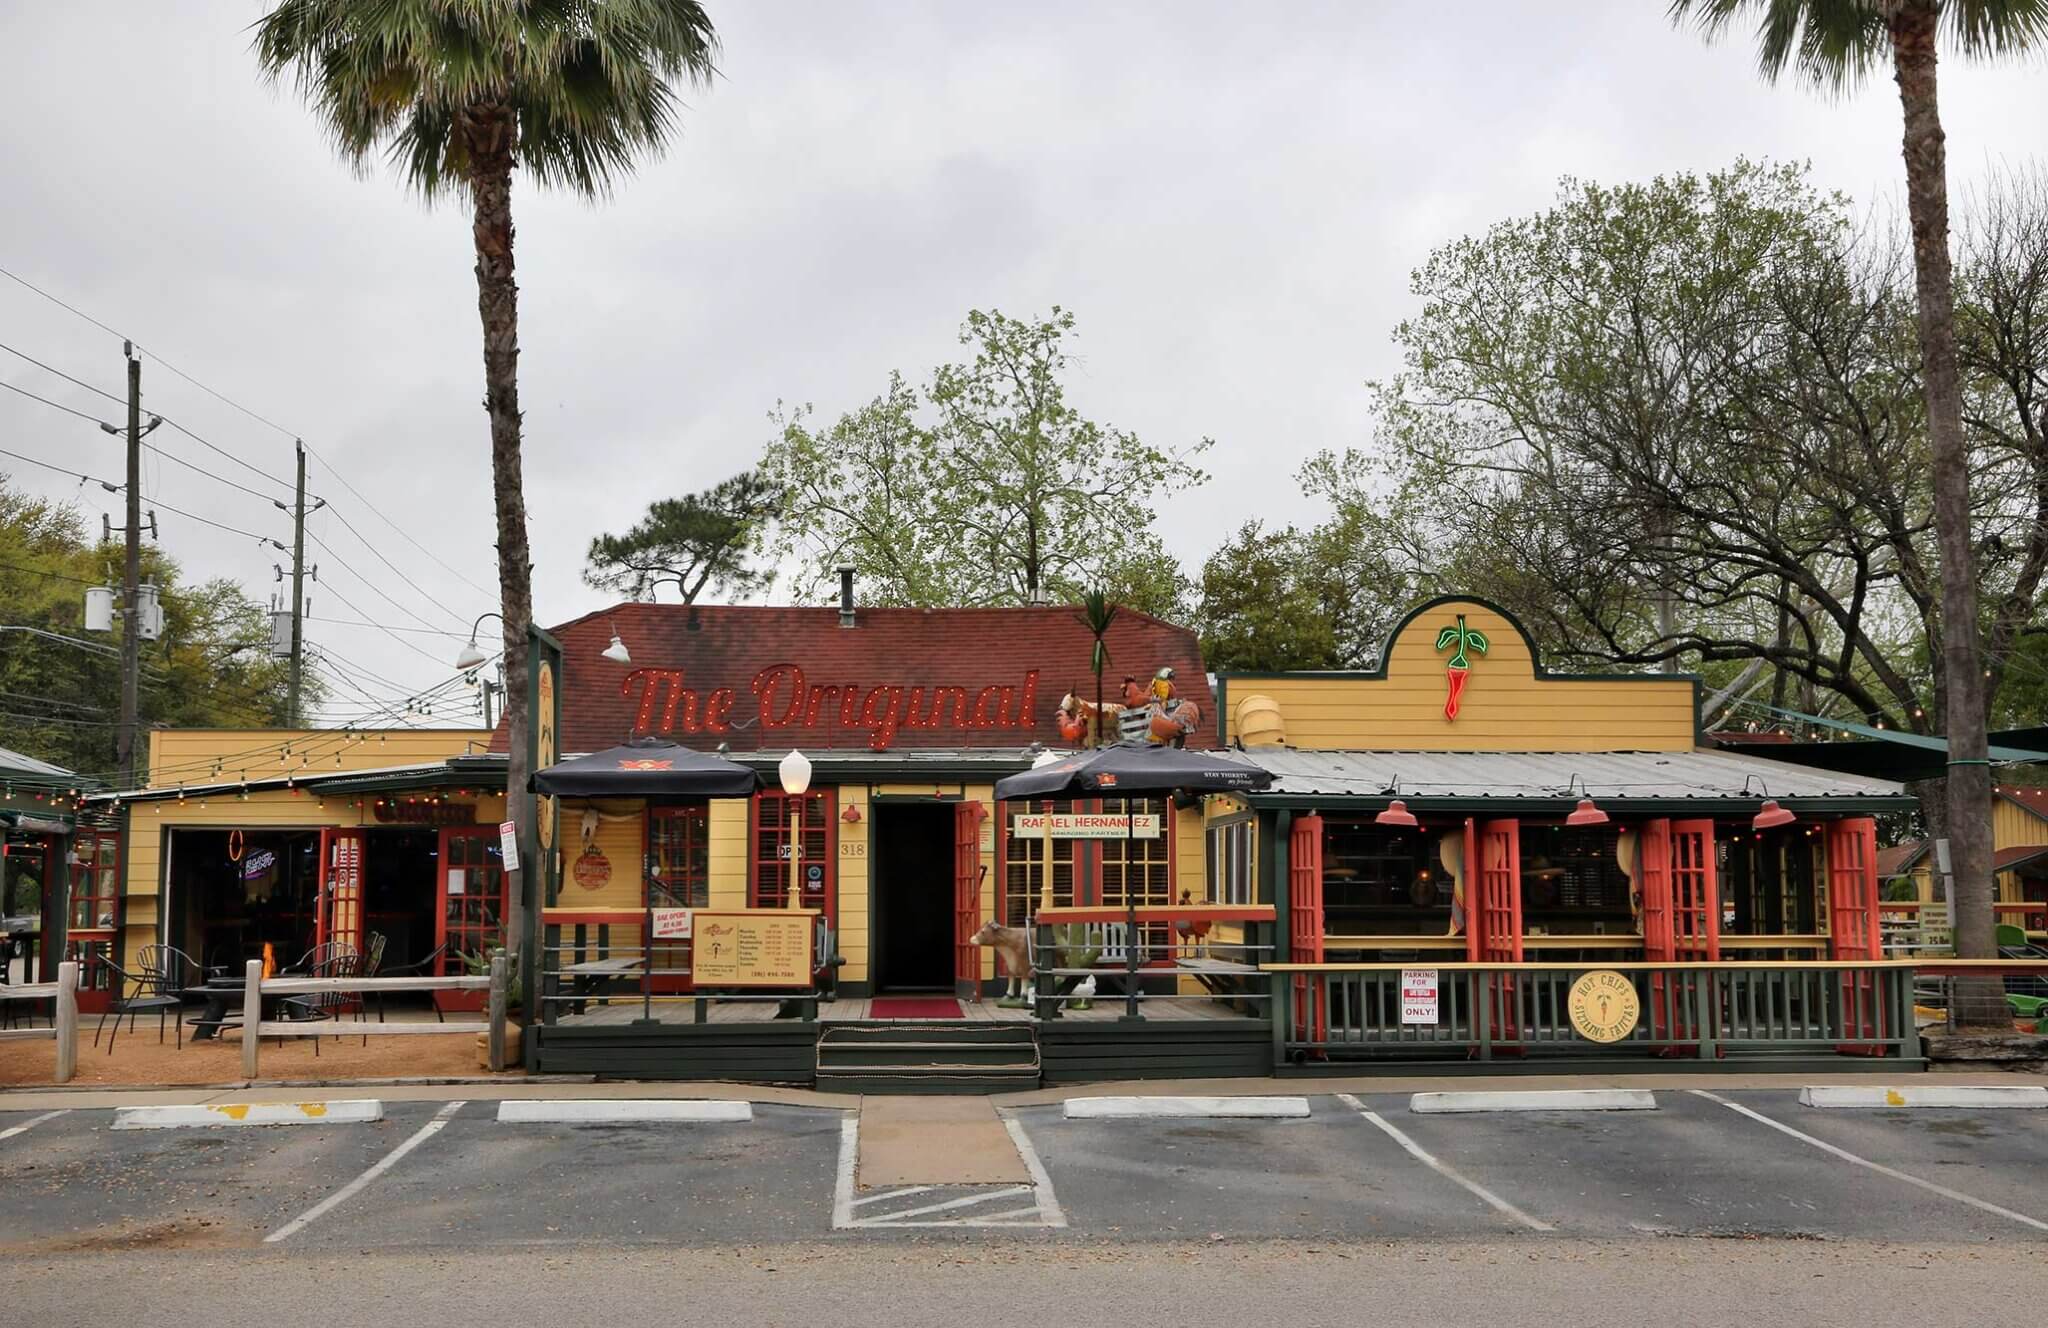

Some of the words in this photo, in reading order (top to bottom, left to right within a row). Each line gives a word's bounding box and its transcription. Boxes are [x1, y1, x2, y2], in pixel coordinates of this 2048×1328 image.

[622, 666, 736, 735] The
[751, 663, 1040, 752] Original
[841, 844, 865, 856] 318
[1577, 977, 1596, 997] HOT
[1600, 974, 1629, 996] CHIPS
[1405, 1008, 1435, 1016] ONLY!
[1575, 1004, 1605, 1038] SIZZLING
